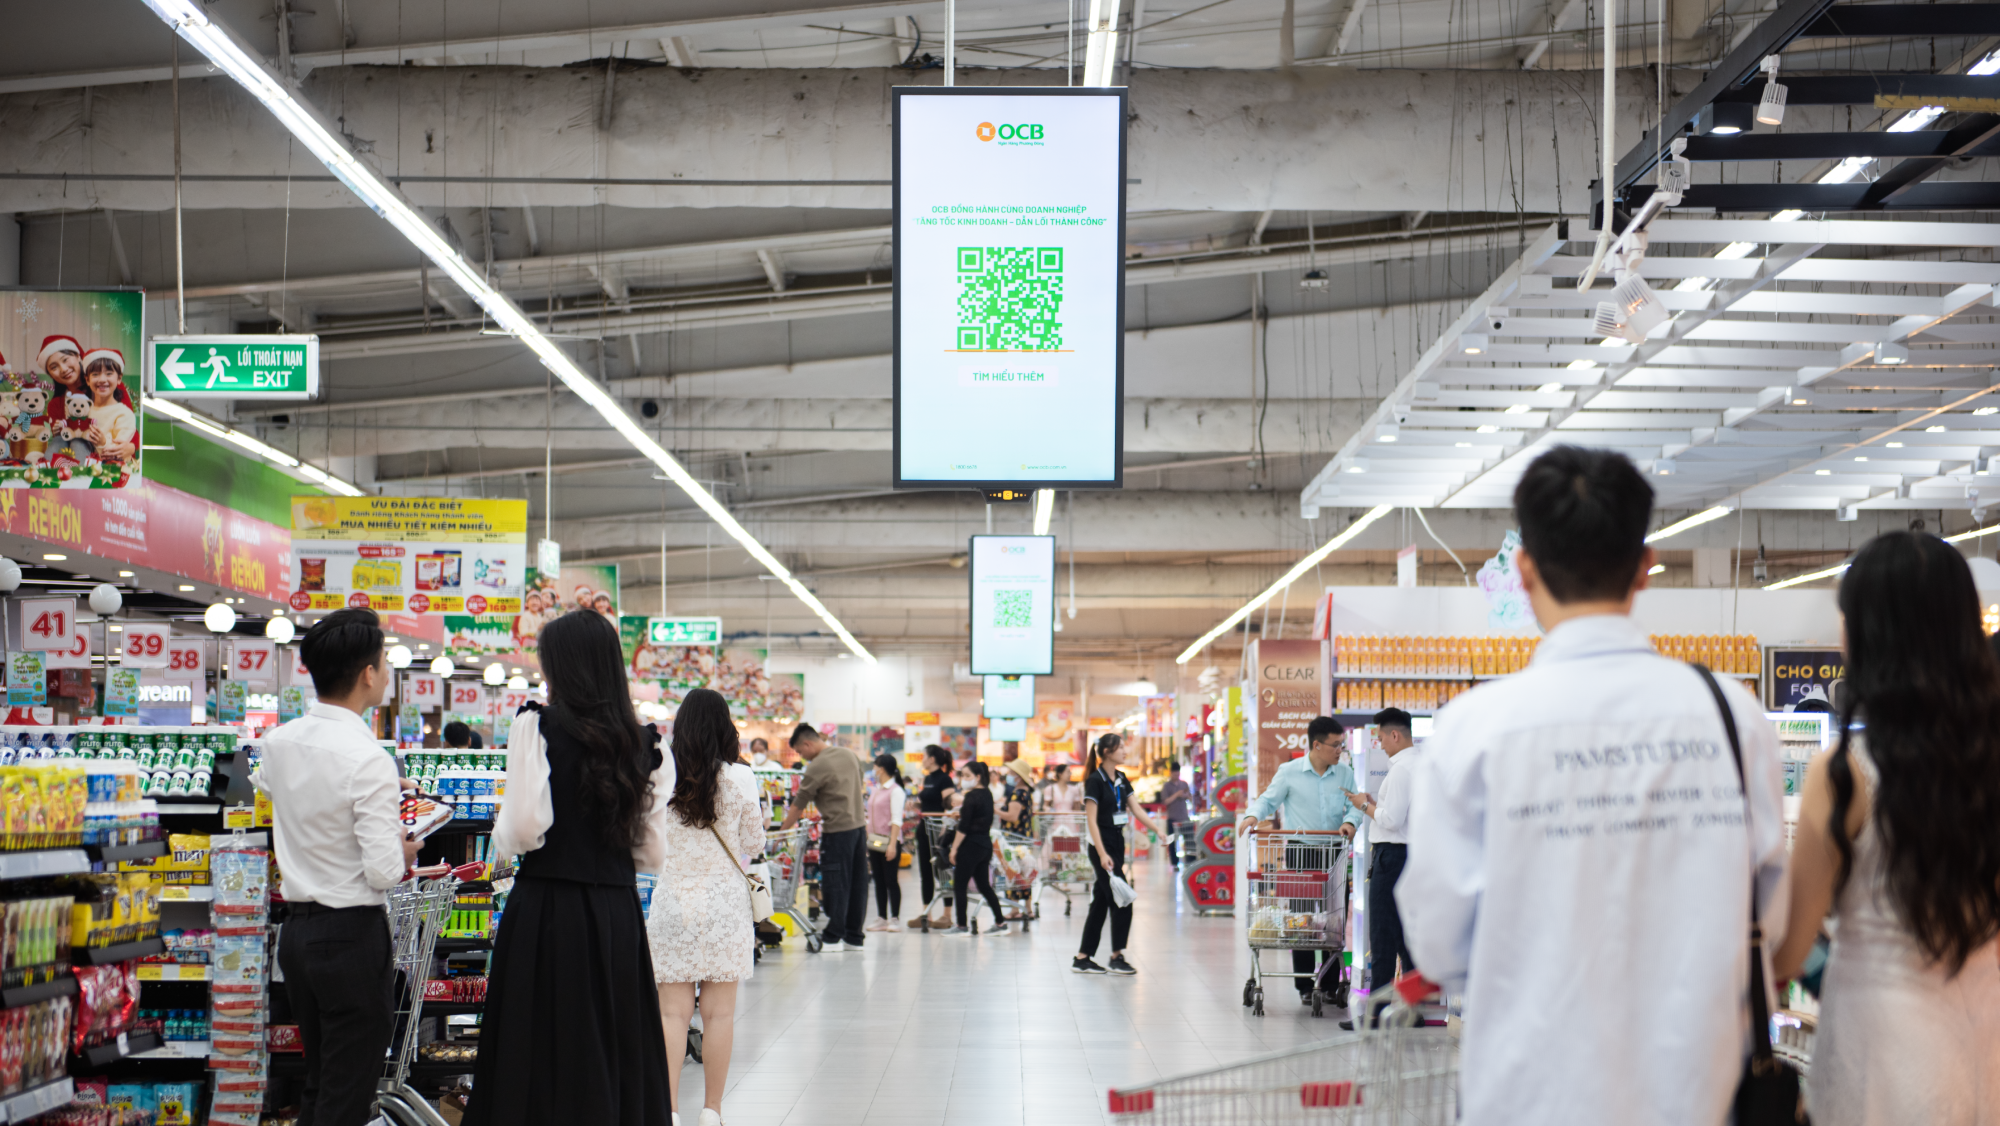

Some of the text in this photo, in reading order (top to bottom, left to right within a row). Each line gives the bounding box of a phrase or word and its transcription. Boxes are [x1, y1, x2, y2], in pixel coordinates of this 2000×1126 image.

[998, 123, 1045, 140] OCB
[932, 205, 949, 213] OCB
[976, 204, 1000, 213] HÀNH
[1025, 205, 1055, 213] DOANH
[1056, 204, 1087, 215] NGHIỆP
[957, 218, 978, 226] KINH
[979, 218, 1008, 226] DOANH
[1035, 216, 1048, 226] LỐI
[1050, 217, 1079, 226] THÀNH
[237, 345, 303, 370] LỐI THOÁT NẠN
[253, 371, 292, 387] EXIT
[972, 369, 1044, 381] TÌM HIỂU THÊM
[340, 520, 365, 529] MUA
[30, 610, 66, 638] 41
[126, 633, 164, 657] 39
[169, 650, 200, 671] 38
[237, 650, 270, 671] 37
[1263, 664, 1314, 680] CLEAR
[1776, 665, 1814, 678] CHO
[415, 679, 435, 695] 31
[455, 688, 478, 704] 29
[506, 693, 527, 708] 27
[1262, 687, 1275, 708] 9
[1554, 738, 1720, 772] PAMSTUDIO
[427, 982, 446, 996] KitKat
[271, 1028, 296, 1046] KitKat
